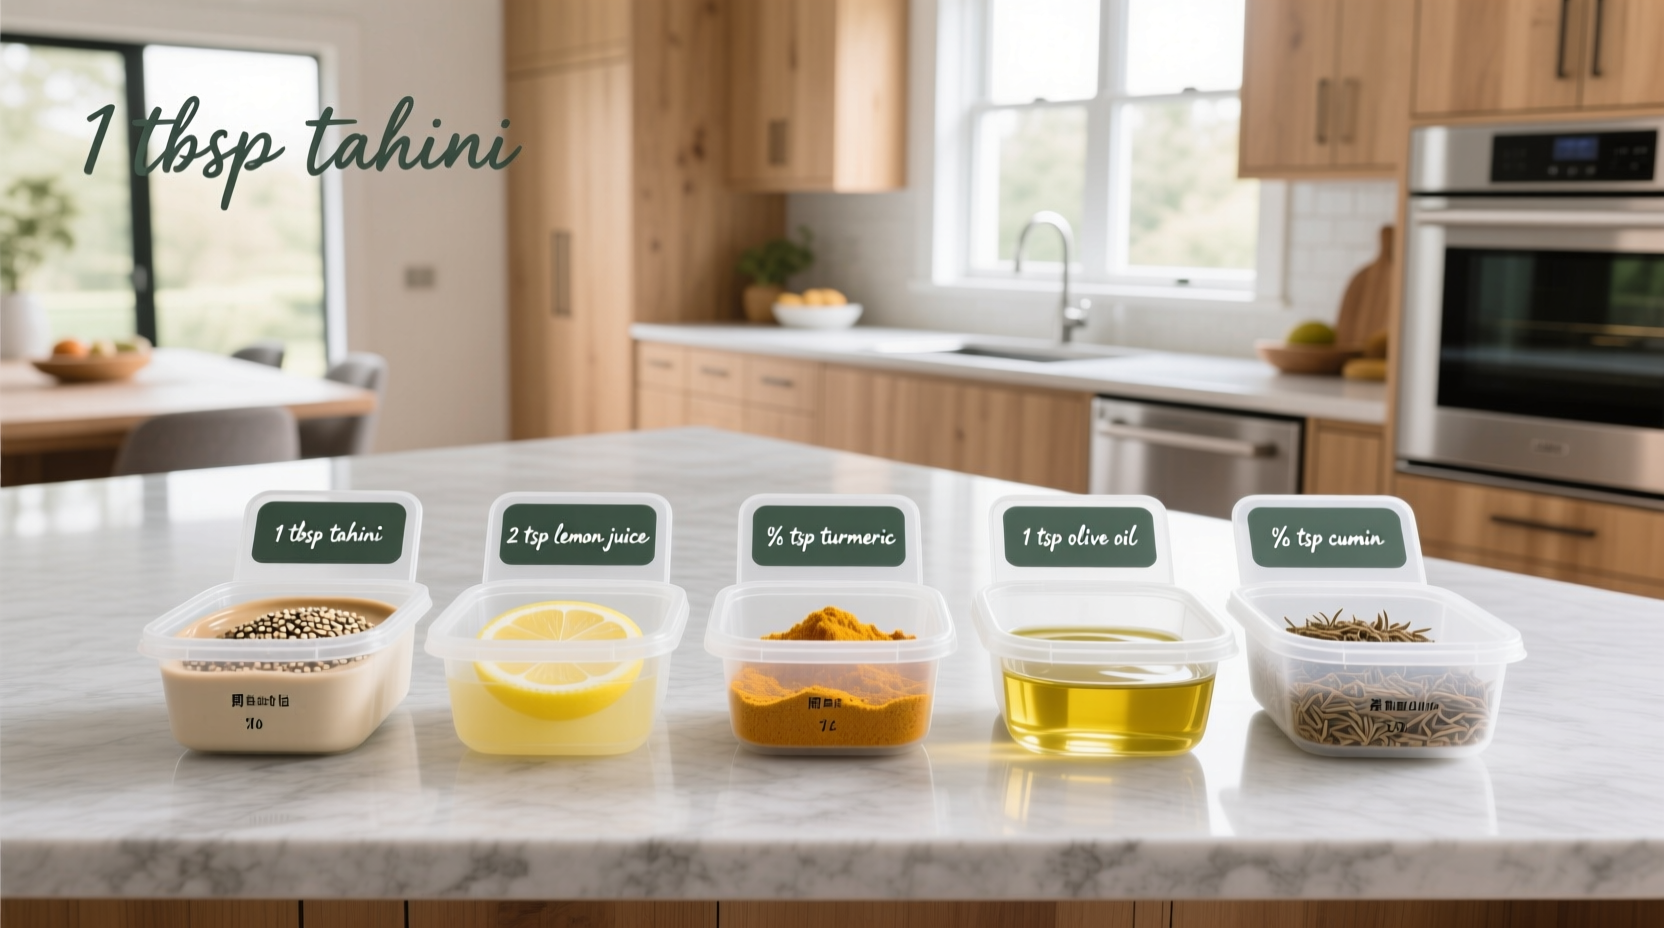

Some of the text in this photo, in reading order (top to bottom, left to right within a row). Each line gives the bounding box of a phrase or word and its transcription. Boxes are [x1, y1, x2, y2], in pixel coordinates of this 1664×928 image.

[275, 520, 383, 550] 1 tbsp tahini
[506, 522, 651, 552] 2 tsp lemon juice
[789, 526, 815, 553] tsp
[819, 526, 897, 546] turmeric
[1023, 523, 1139, 553] 1 tsp olive oil
[1296, 527, 1323, 554] tsp
[1328, 529, 1386, 547] cumin
